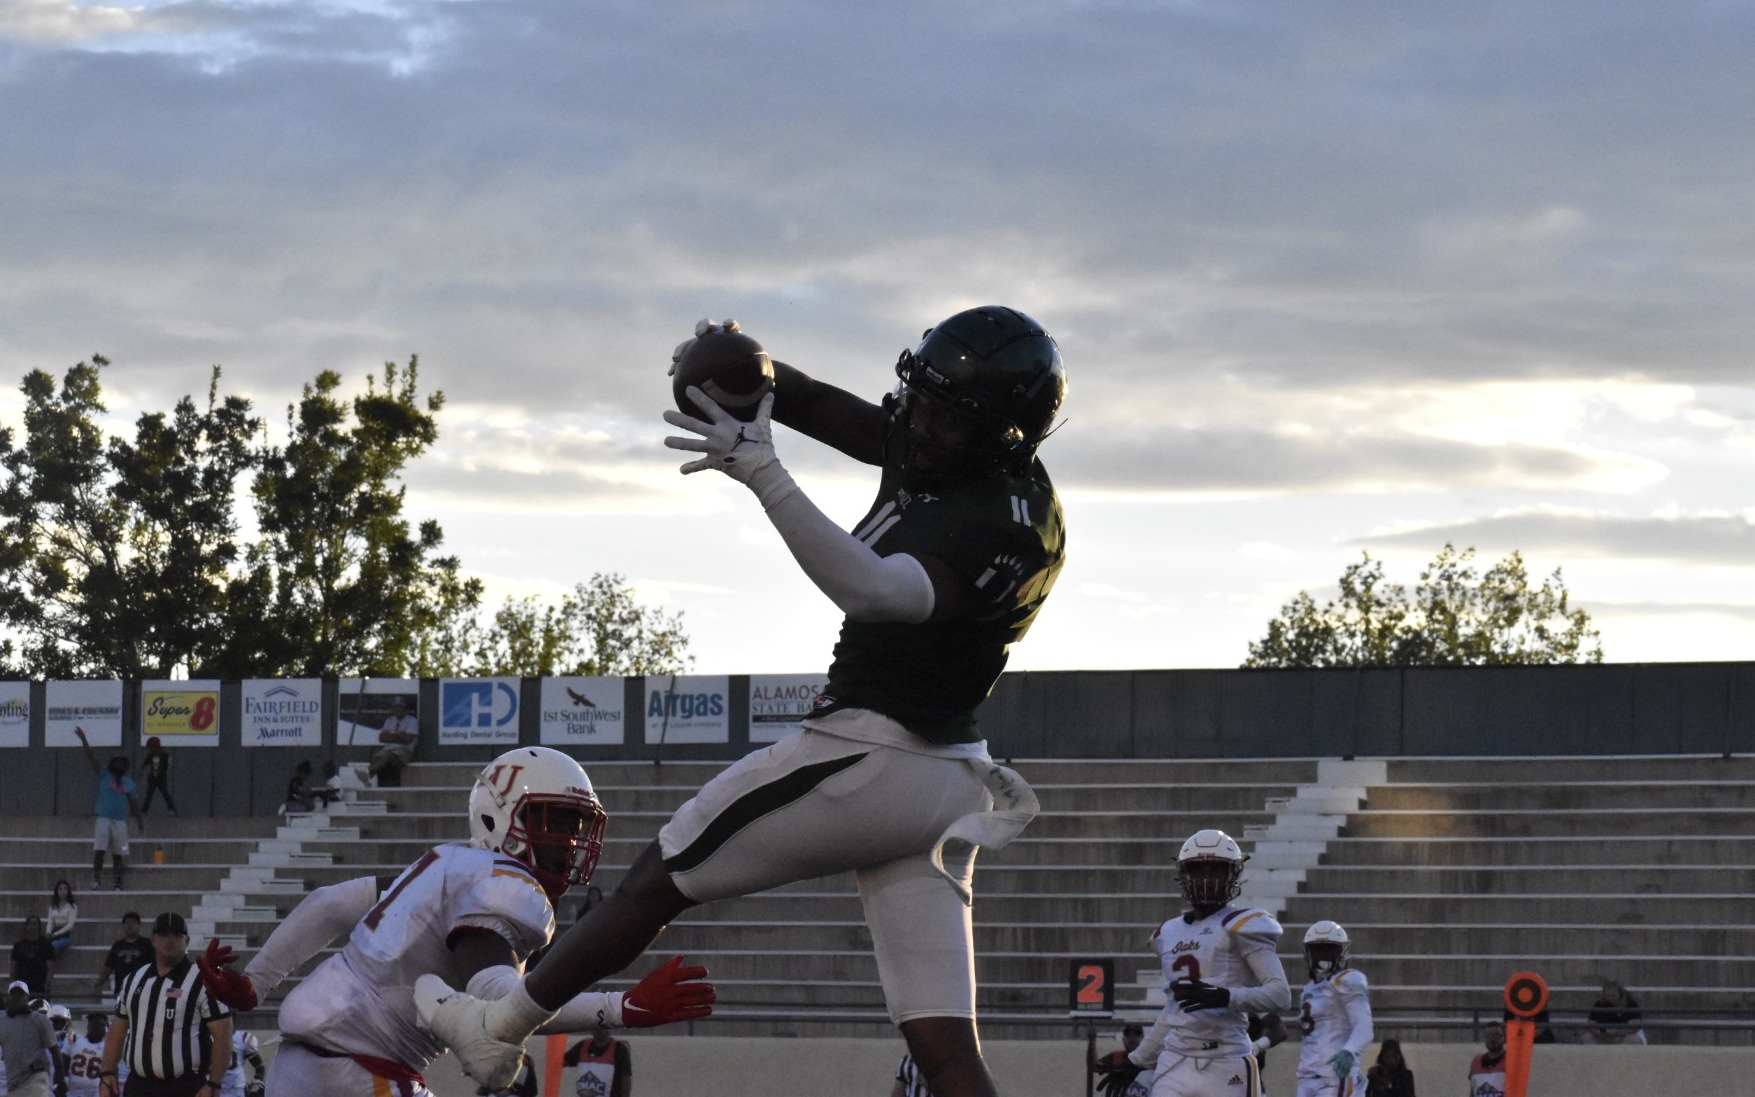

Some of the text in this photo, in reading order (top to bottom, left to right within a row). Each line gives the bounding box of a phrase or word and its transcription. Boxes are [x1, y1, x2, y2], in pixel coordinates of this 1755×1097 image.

[147, 696, 216, 732] Super 8
[245, 697, 319, 715] FAIRFIELD
[567, 721, 597, 735] Bank
[1077, 965, 1105, 1003] 2
[166, 1008, 175, 1020] U
[71, 1053, 101, 1080] 26
